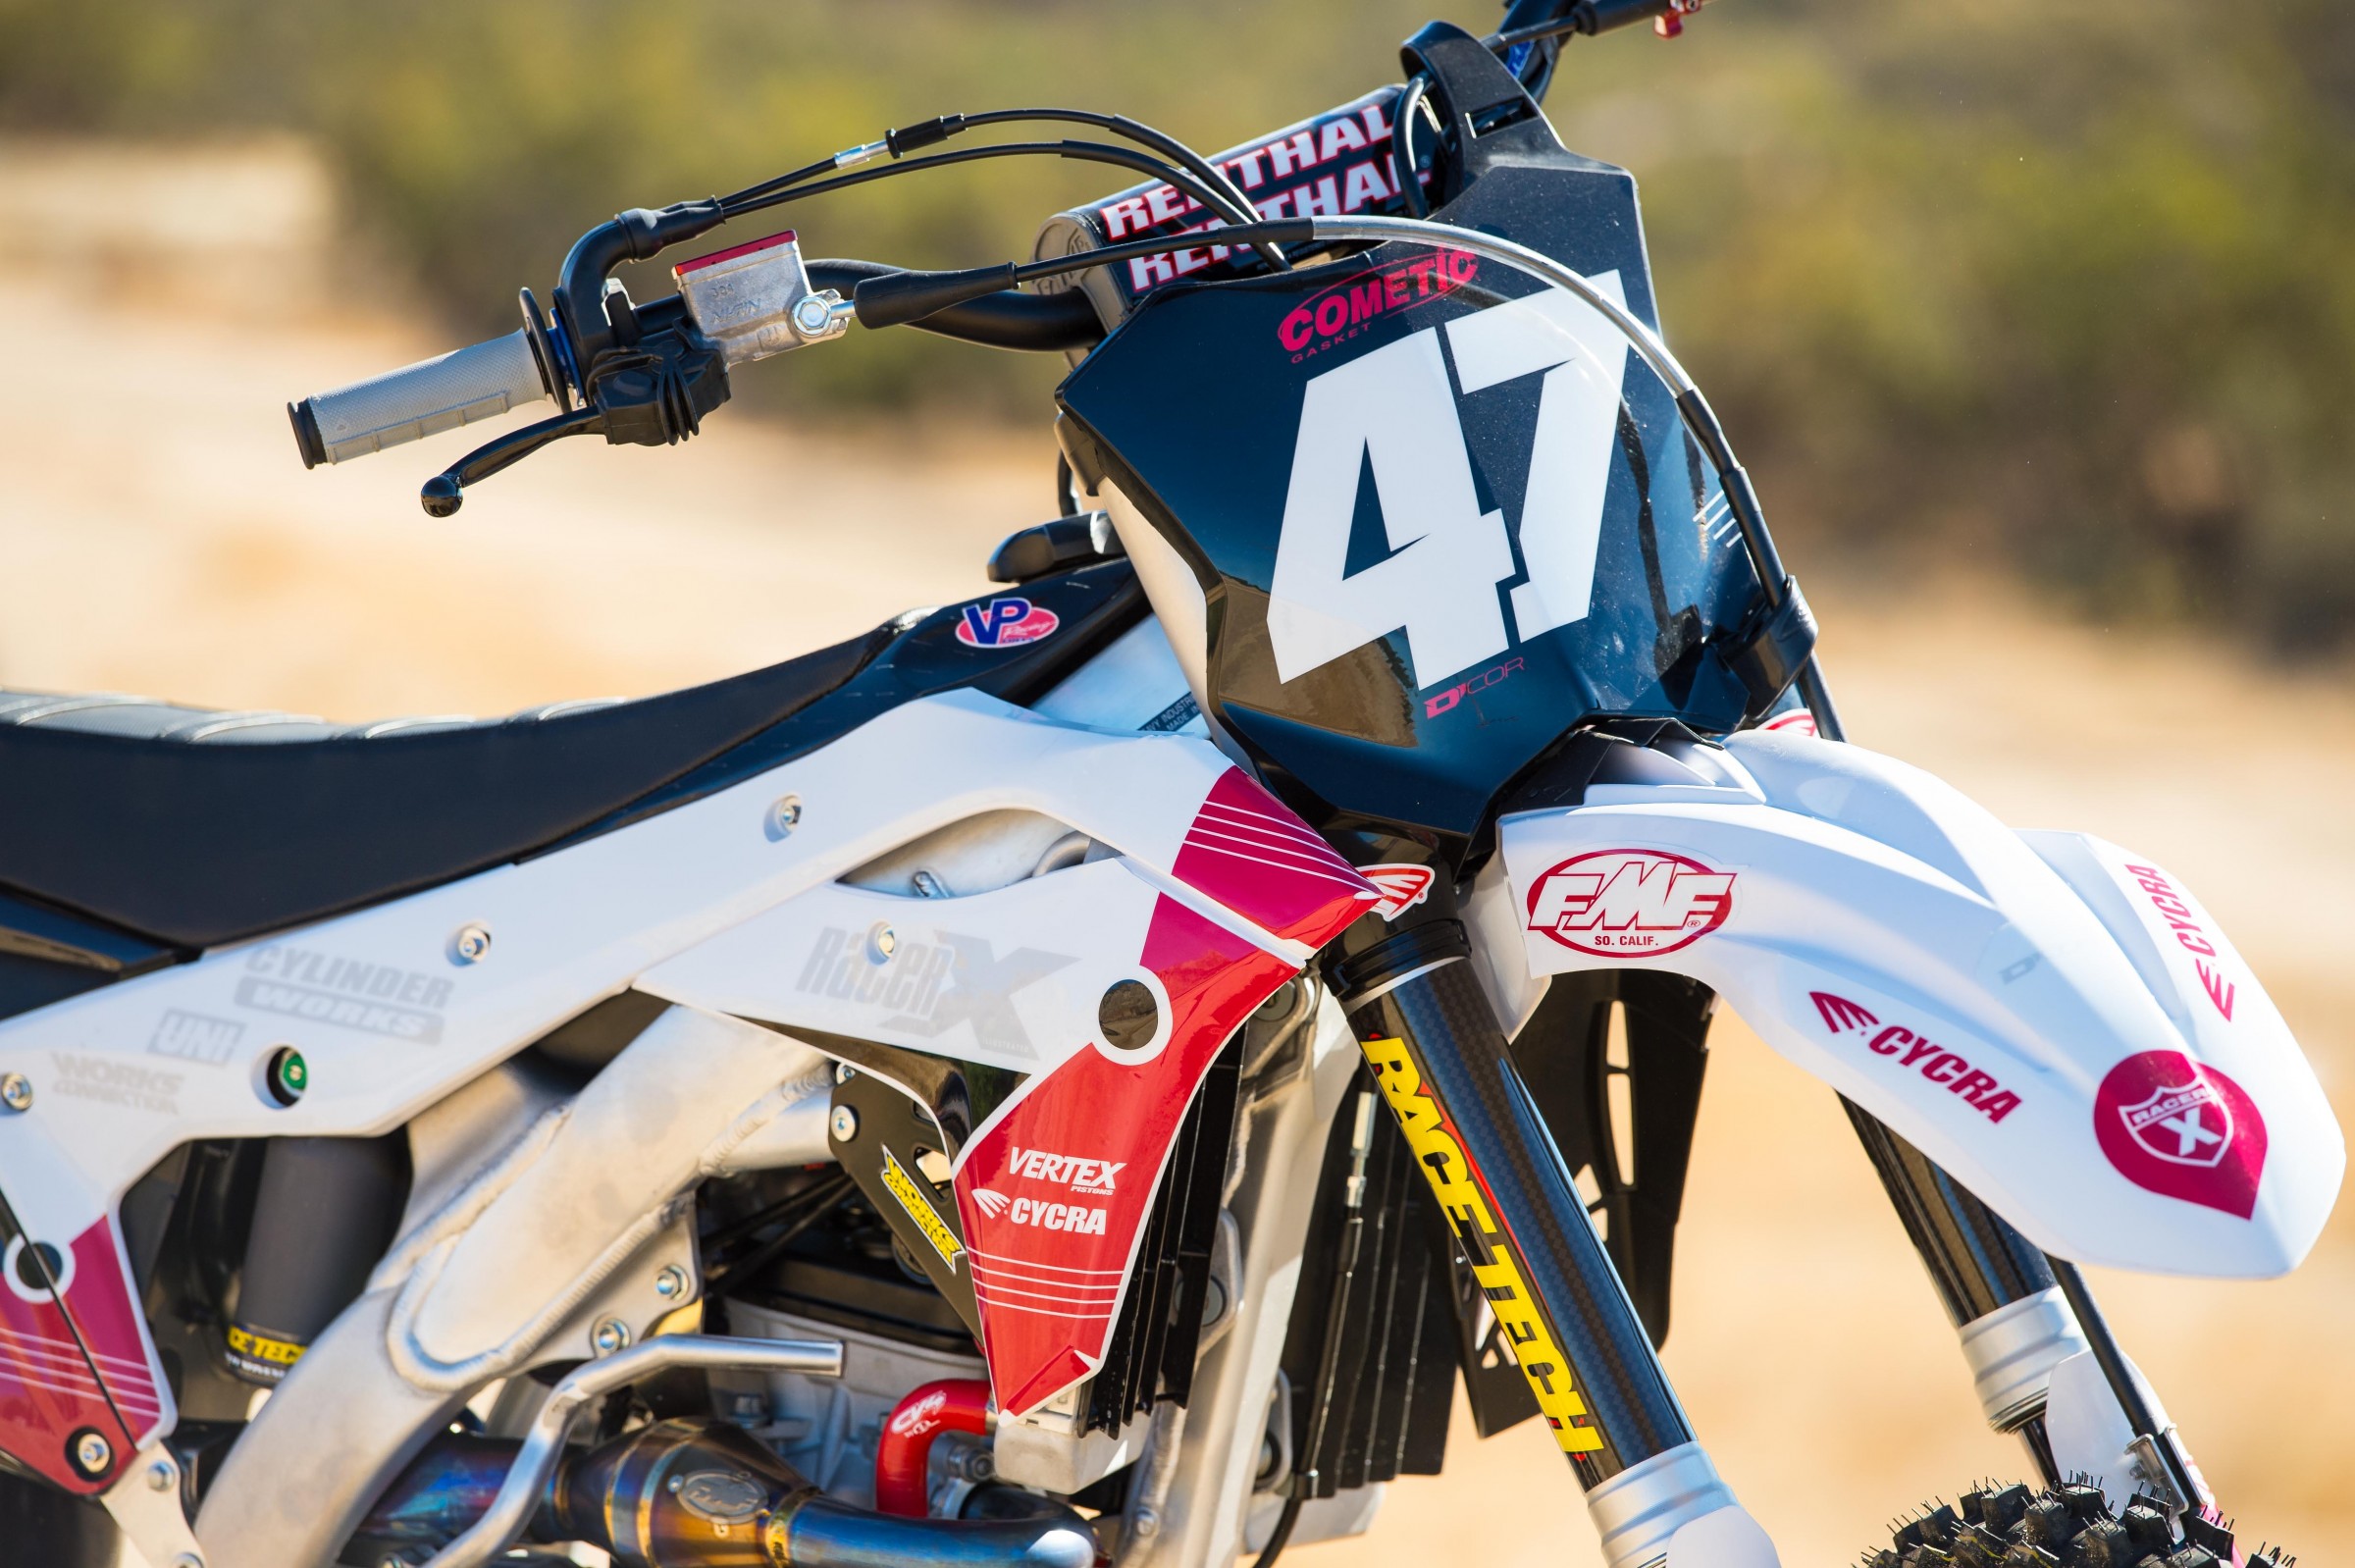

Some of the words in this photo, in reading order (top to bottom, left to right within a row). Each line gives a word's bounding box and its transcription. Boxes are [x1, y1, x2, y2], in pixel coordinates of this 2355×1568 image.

[1100, 103, 1393, 242] RETHAL
[1280, 245, 1478, 351] COMETIC
[1290, 322, 1373, 364] GASKET
[1267, 269, 1630, 692] 47
[963, 598, 1032, 647] VP
[1527, 861, 1738, 931] FMF
[2123, 863, 2218, 958] CYCRA
[1595, 935, 1615, 946] SO.
[1619, 935, 1659, 946] CALIF.
[245, 946, 455, 1009] CYLINDER
[251, 985, 429, 1037] WORKS
[152, 1011, 238, 1064] UNI
[1868, 1025, 2023, 1124] CYCRA
[2130, 1086, 2209, 1125] RACER
[2159, 1106, 2224, 1158] X
[1009, 1146, 1127, 1189] VERTEX
[1071, 1184, 1115, 1196] PISTONS
[1011, 1197, 1108, 1235] CYCRA
